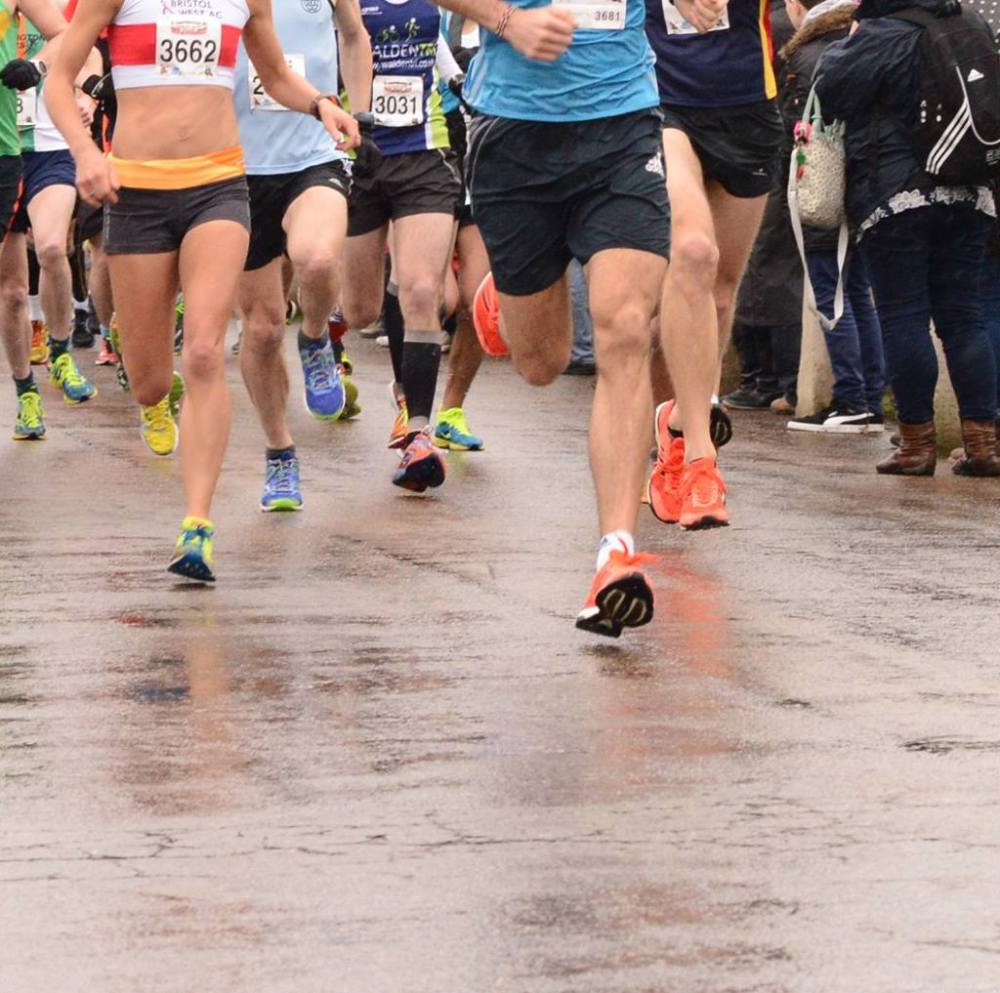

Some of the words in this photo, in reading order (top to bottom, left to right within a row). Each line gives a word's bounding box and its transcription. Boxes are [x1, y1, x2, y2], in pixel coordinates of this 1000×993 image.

[170, 0, 213, 9] BRISTOL
[594, 10, 620, 21] 3681
[160, 39, 217, 63] 3662
[375, 96, 416, 115] 3031
